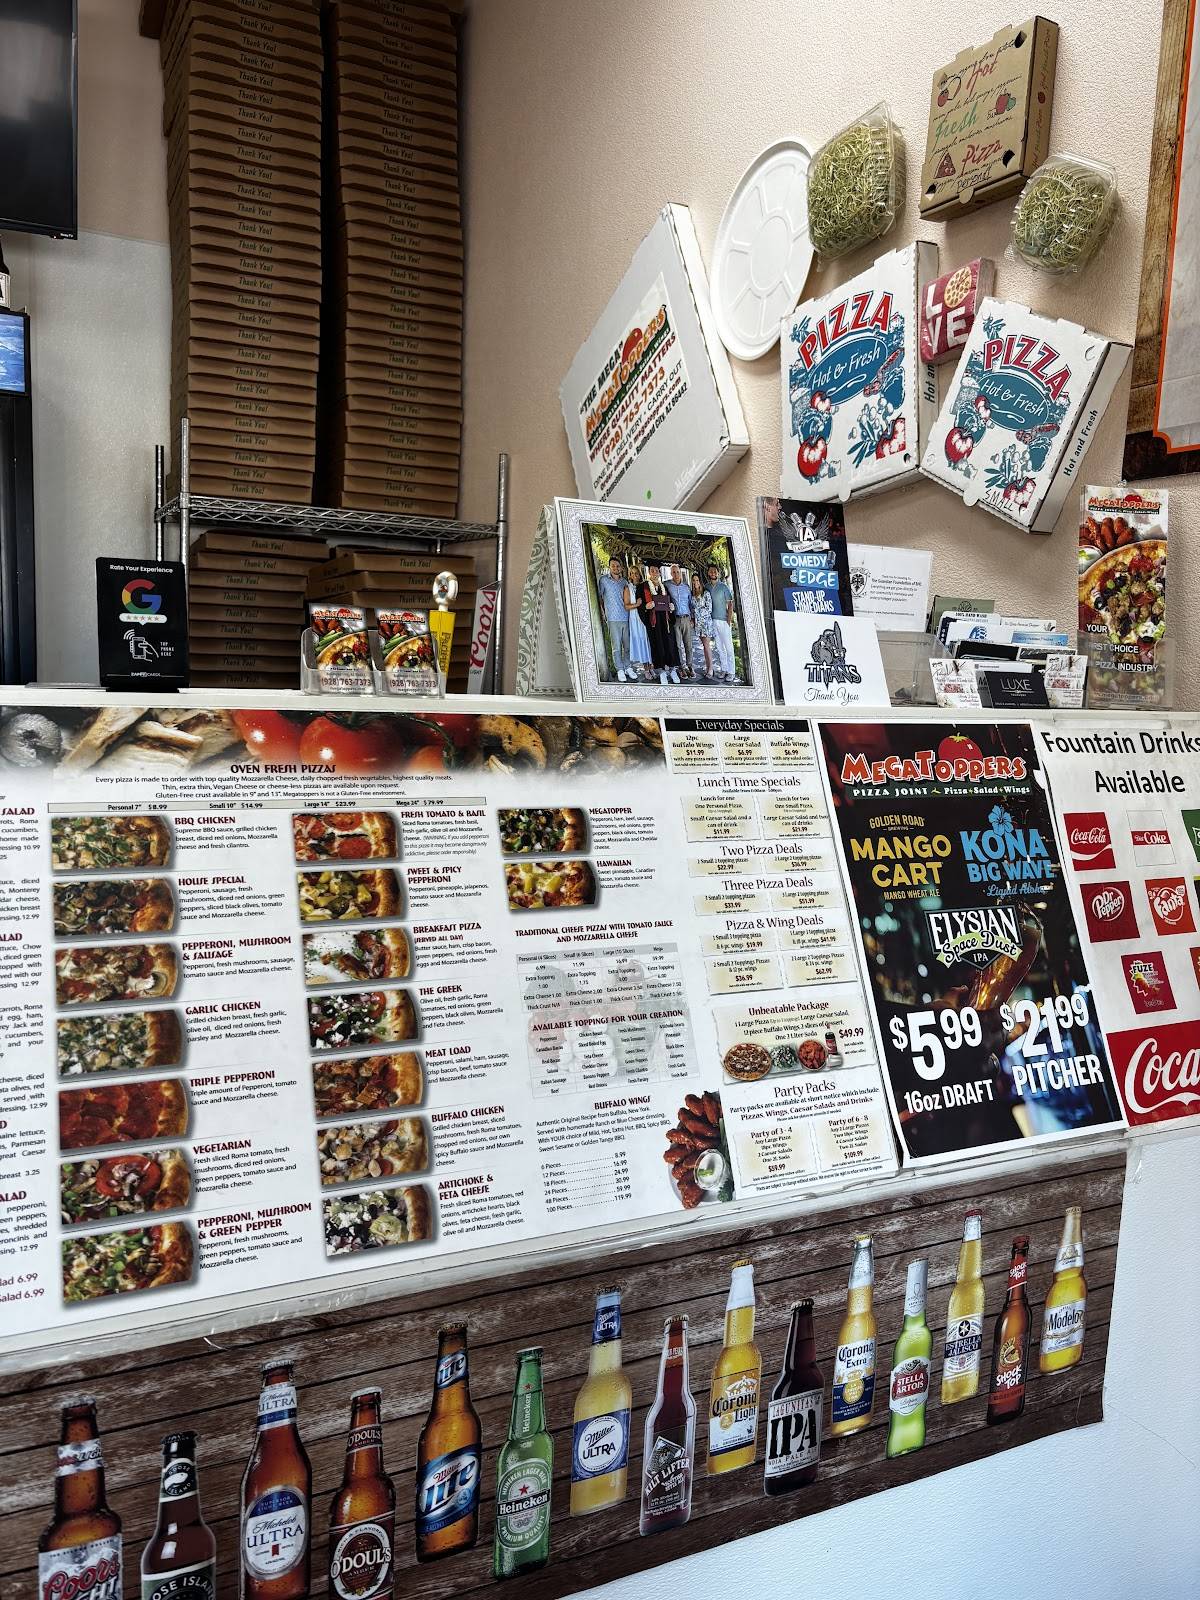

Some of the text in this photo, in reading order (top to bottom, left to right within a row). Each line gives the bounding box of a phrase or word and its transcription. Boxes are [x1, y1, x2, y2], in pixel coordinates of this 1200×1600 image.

[242, 37, 260, 46] Thank
[799, 291, 893, 370] PIZZA
[811, 345, 881, 390] Hot & Fresh
[984, 335, 1072, 401] PIZZA
[590, 334, 676, 463] WHERE QUALITY MATTERS
[924, 381, 936, 404] Hot
[980, 379, 1045, 417] Hot & Fresh
[602, 365, 665, 463] (928) 763-7373
[1063, 409, 1098, 477] Hot and Fresh
[984, 488, 1014, 512] SMALL
[400, 559, 432, 568] Thank You!
[782, 555, 827, 567] COMEDY
[140, 566, 173, 574] Experience
[799, 570, 836, 587] EDGE
[792, 591, 825, 602] STAND-UP
[469, 589, 497, 668] Coors
[1086, 624, 1109, 633] YOUR
[1112, 644, 1139, 654] CHOICE
[805, 662, 862, 683] TITANS
[1095, 662, 1159, 672] PIZZA INDUSTRY
[1001, 680, 1033, 690] LUXE
[804, 687, 859, 706] Thank You
[696, 720, 784, 731] Everyday Specials
[1041, 731, 1200, 754] Fountain Drinks
[231, 764, 336, 774] OVEN FRESH PIZZAS
[697, 777, 801, 788] Lunch Time Specials
[1095, 770, 1186, 794] Available
[853, 787, 928, 796] PIZZA JOINT
[869, 815, 924, 829] GOLDEN ROAD
[959, 829, 1050, 862] KONA
[1143, 830, 1167, 845] Coke
[720, 843, 803, 856] Two Pizza Deals
[850, 834, 951, 861] MANGO
[407, 867, 430, 875] SWEET
[872, 862, 943, 887] CART
[967, 860, 1055, 883] BIG WAVE
[178, 876, 246, 886] HOUSE SPECIAL
[408, 876, 451, 884] PEPPERONI
[884, 891, 906, 900] MANGO
[907, 890, 928, 899] WHEAT
[1096, 892, 1123, 919] Pepper
[1153, 893, 1184, 921] Fanta
[413, 923, 481, 934] BREAKFAST PIZZA
[928, 907, 1021, 949] ELYSIAN
[182, 936, 291, 950] PEPPERONI, MUSHROOM
[942, 930, 1017, 964] Space Dust
[182, 950, 233, 961] & SAUSAGE
[973, 952, 988, 962] IPA
[1132, 964, 1154, 974] FUZE
[420, 985, 462, 996] THE GREEK
[185, 1001, 261, 1015] GARLIC CHICKEN
[748, 1001, 829, 1016] Unbeatable Package
[839, 1028, 864, 1038] $49.99
[425, 1046, 471, 1058] MEAT LOAD
[190, 1070, 275, 1088] TRIPLE PEPPERONI
[1012, 1054, 1104, 1097] PITCHER
[774, 1080, 836, 1097] Party Packs
[904, 1079, 994, 1114] 16oz DRAFT
[594, 1096, 651, 1110] BUFFALO WINGS
[431, 1106, 505, 1123] BUFFALO CHICKEN
[193, 1140, 251, 1155] VEGETARIAN
[438, 1174, 494, 1190] ARTICHOKE &
[439, 1185, 490, 1200] FETA CHEESE
[1047, 1308, 1082, 1332] Modelo
[838, 1342, 874, 1361] Corona
[846, 1356, 867, 1369] Extra
[897, 1372, 925, 1387] STELLA
[996, 1365, 1021, 1387] SHOCK
[1005, 1374, 1021, 1390] TOP
[896, 1380, 924, 1396] ARTOIS
[712, 1388, 757, 1417] Corona
[734, 1405, 757, 1422] Light
[586, 1426, 616, 1446] Miller
[768, 1409, 818, 1461] IPA
[582, 1442, 616, 1460] ULTRA
[500, 1492, 548, 1516] Heineken
[253, 1515, 296, 1534] Michelob
[247, 1524, 305, 1548] ULTRA
[331, 1546, 392, 1579] O'DOUL'S
[44, 1556, 121, 1600] Coors
